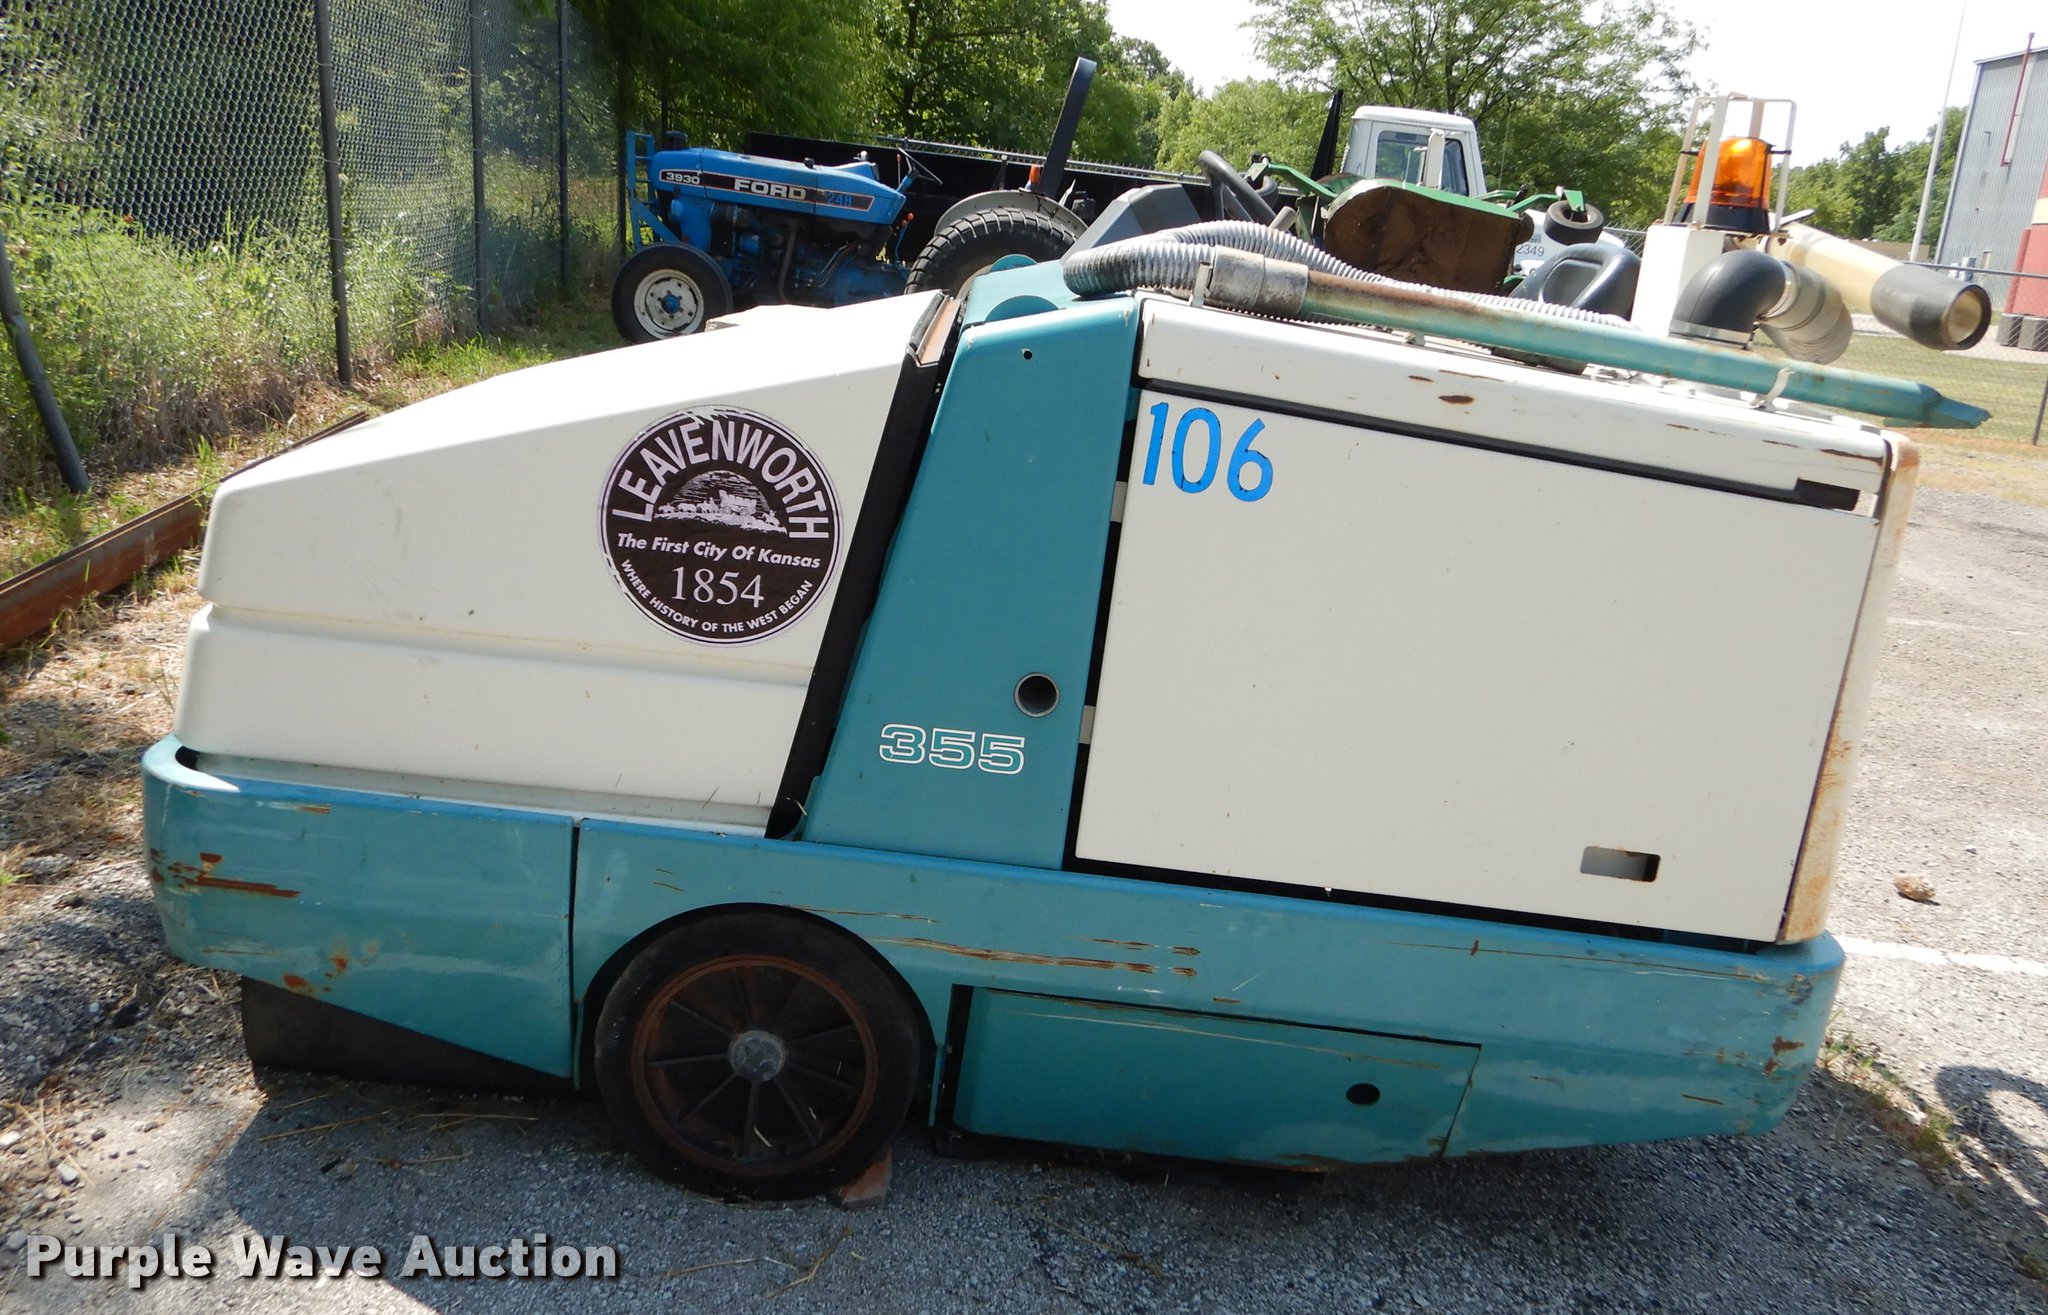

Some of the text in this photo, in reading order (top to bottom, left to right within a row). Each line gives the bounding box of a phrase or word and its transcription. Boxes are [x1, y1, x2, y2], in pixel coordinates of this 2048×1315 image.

[666, 172, 700, 184] 3930
[734, 178, 807, 200] FORD
[826, 191, 852, 206] 248
[1143, 402, 1273, 502] 106
[612, 420, 829, 539] LEAVENWORTH
[617, 532, 821, 569] The First City Of Kansas
[620, 559, 813, 632] WHERE HISTORY OF THE WEST BEGAN
[671, 566, 764, 608] 1854
[879, 723, 1025, 775] 355
